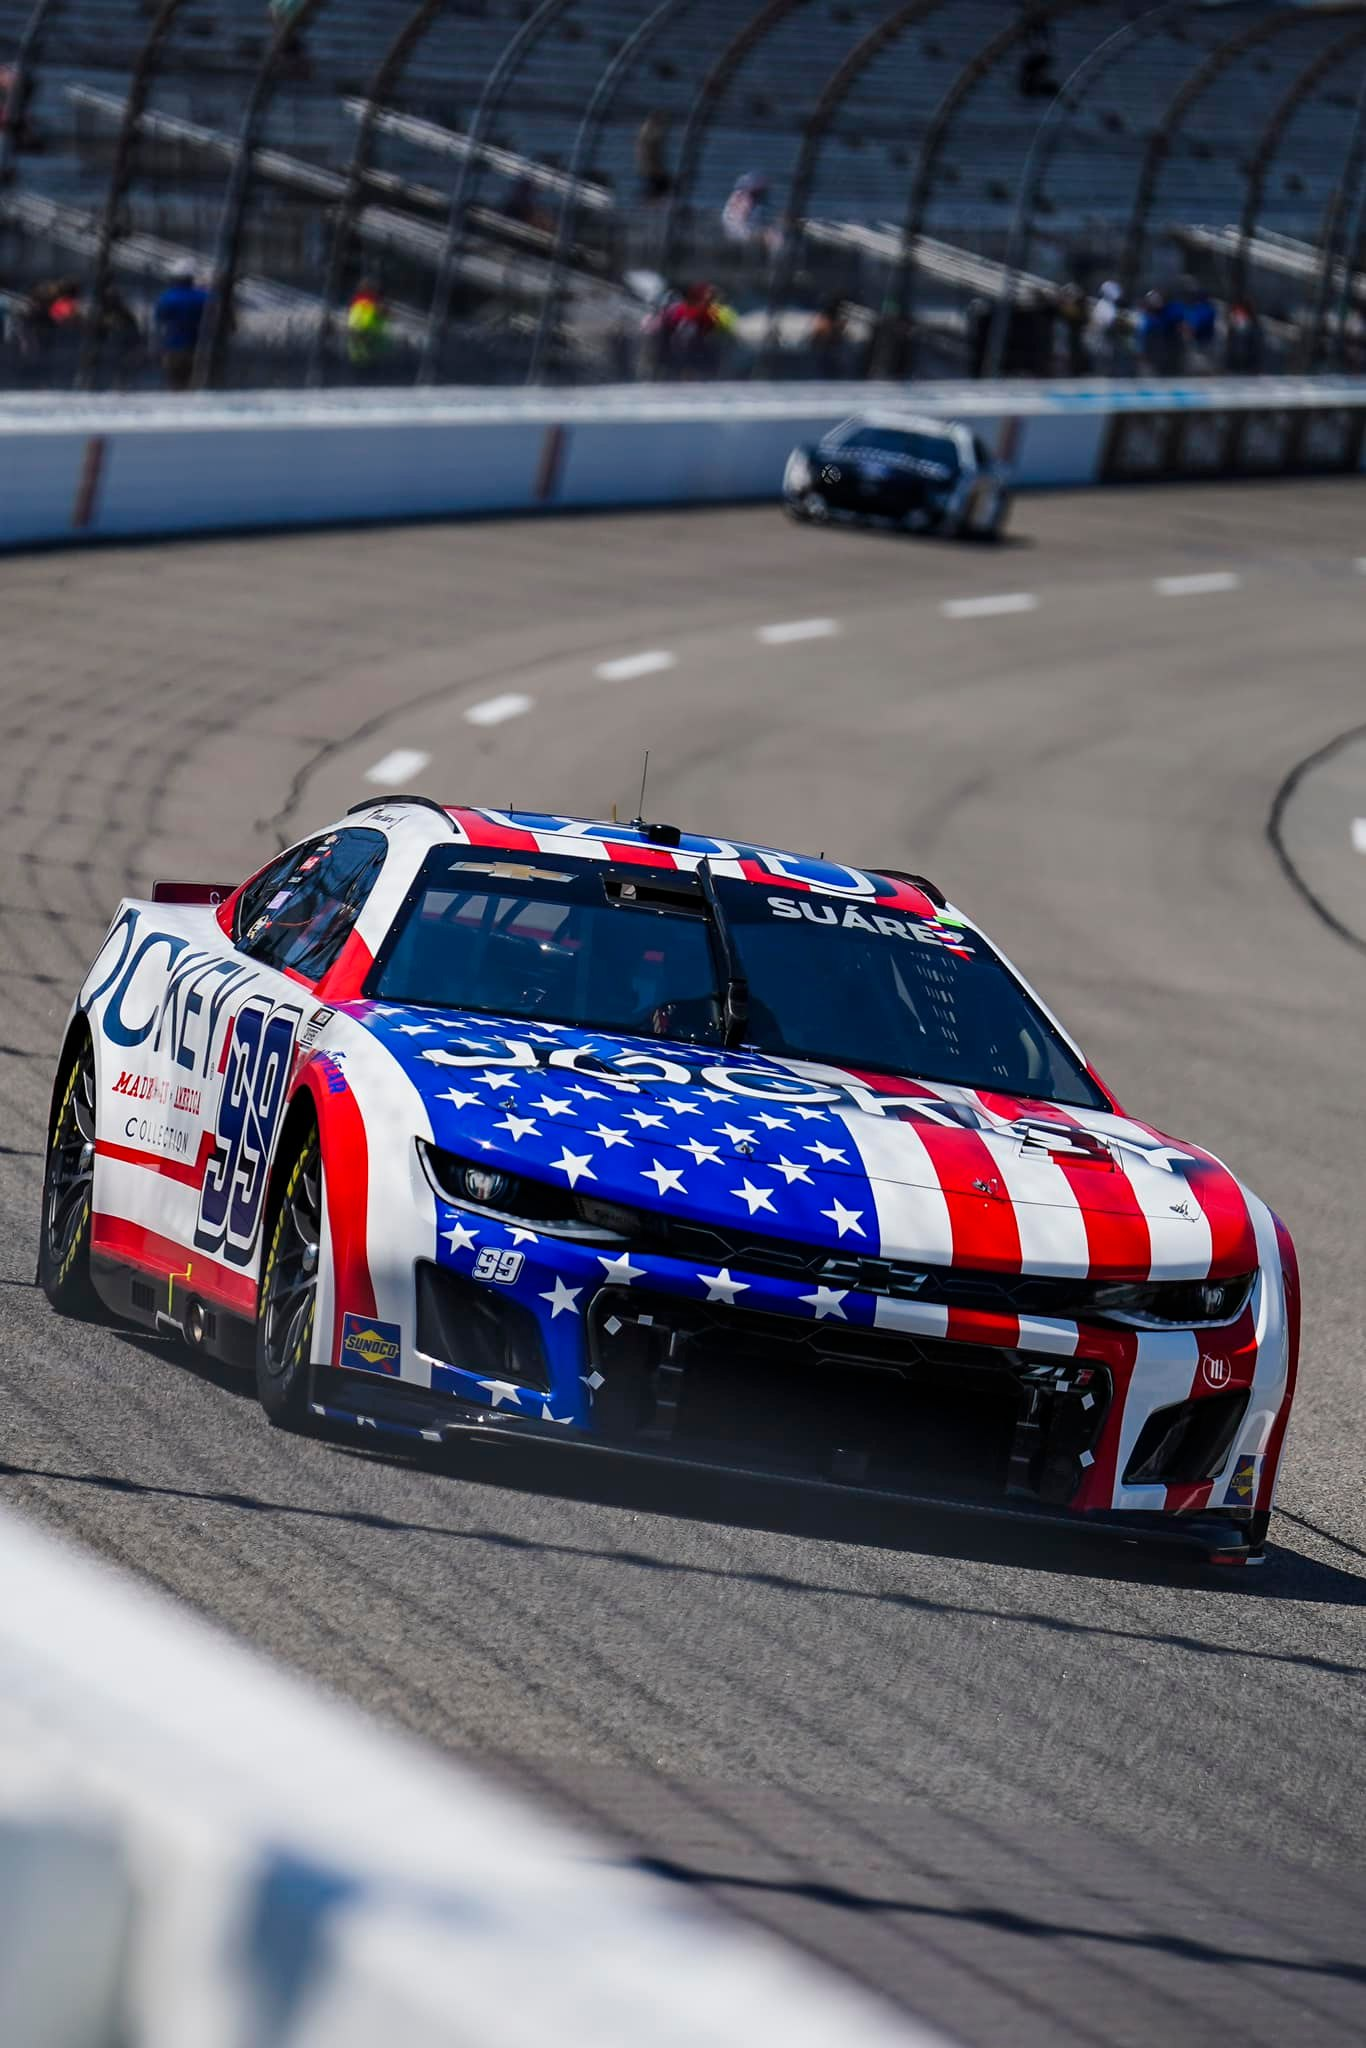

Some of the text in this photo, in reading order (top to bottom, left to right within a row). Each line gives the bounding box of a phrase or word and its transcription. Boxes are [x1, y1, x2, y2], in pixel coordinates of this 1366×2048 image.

[767, 896, 977, 954] SUÁREZ
[193, 994, 304, 1267] 99
[472, 1246, 526, 1286] 99
[346, 1334, 398, 1357] SUNOCO
